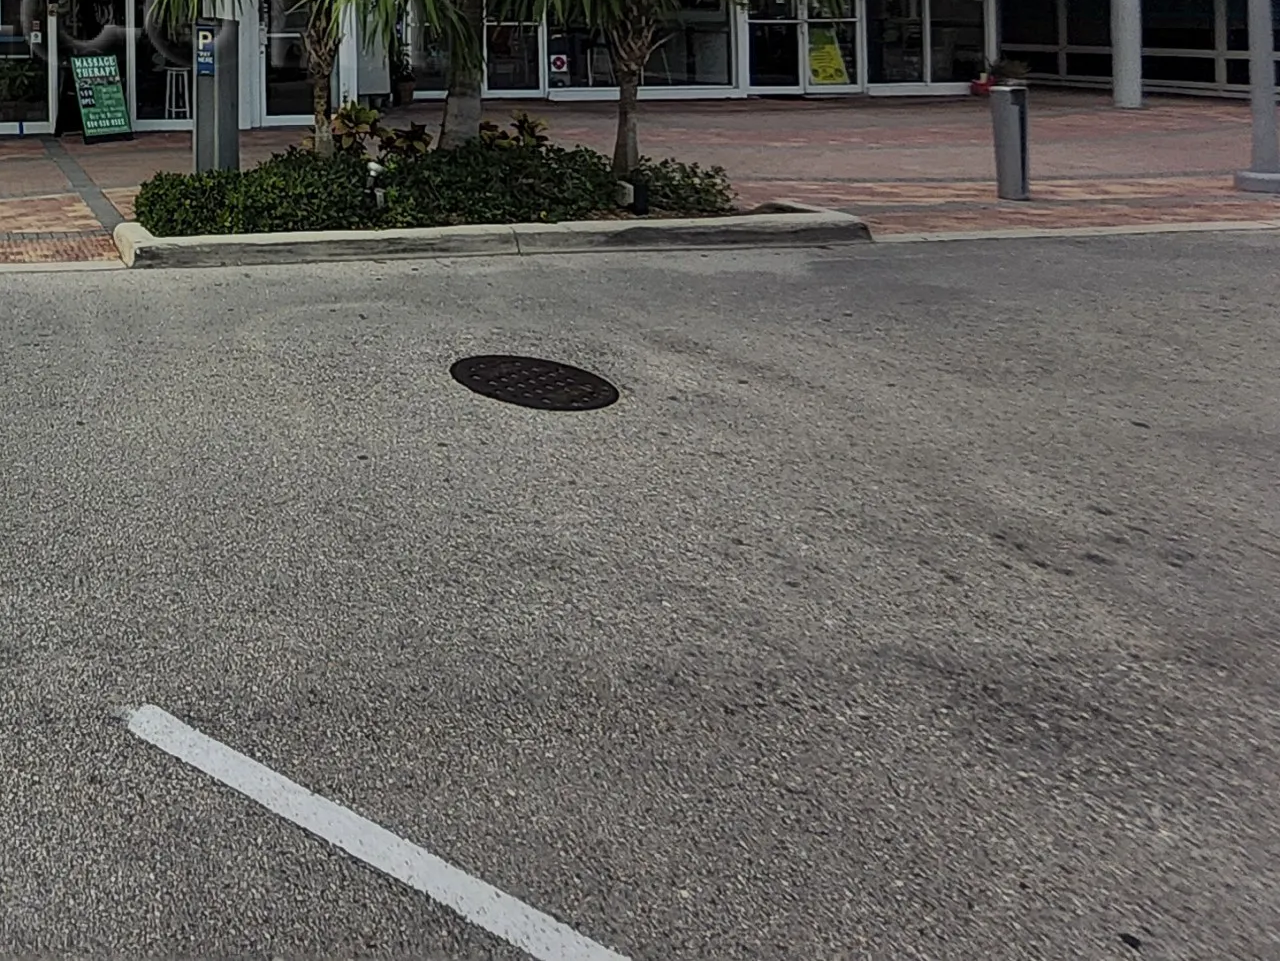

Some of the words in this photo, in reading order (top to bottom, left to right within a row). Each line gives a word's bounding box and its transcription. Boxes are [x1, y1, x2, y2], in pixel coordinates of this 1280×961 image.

[198, 30, 213, 50] P
[74, 56, 116, 68] MASSAGE
[75, 66, 117, 78] THERAPY
